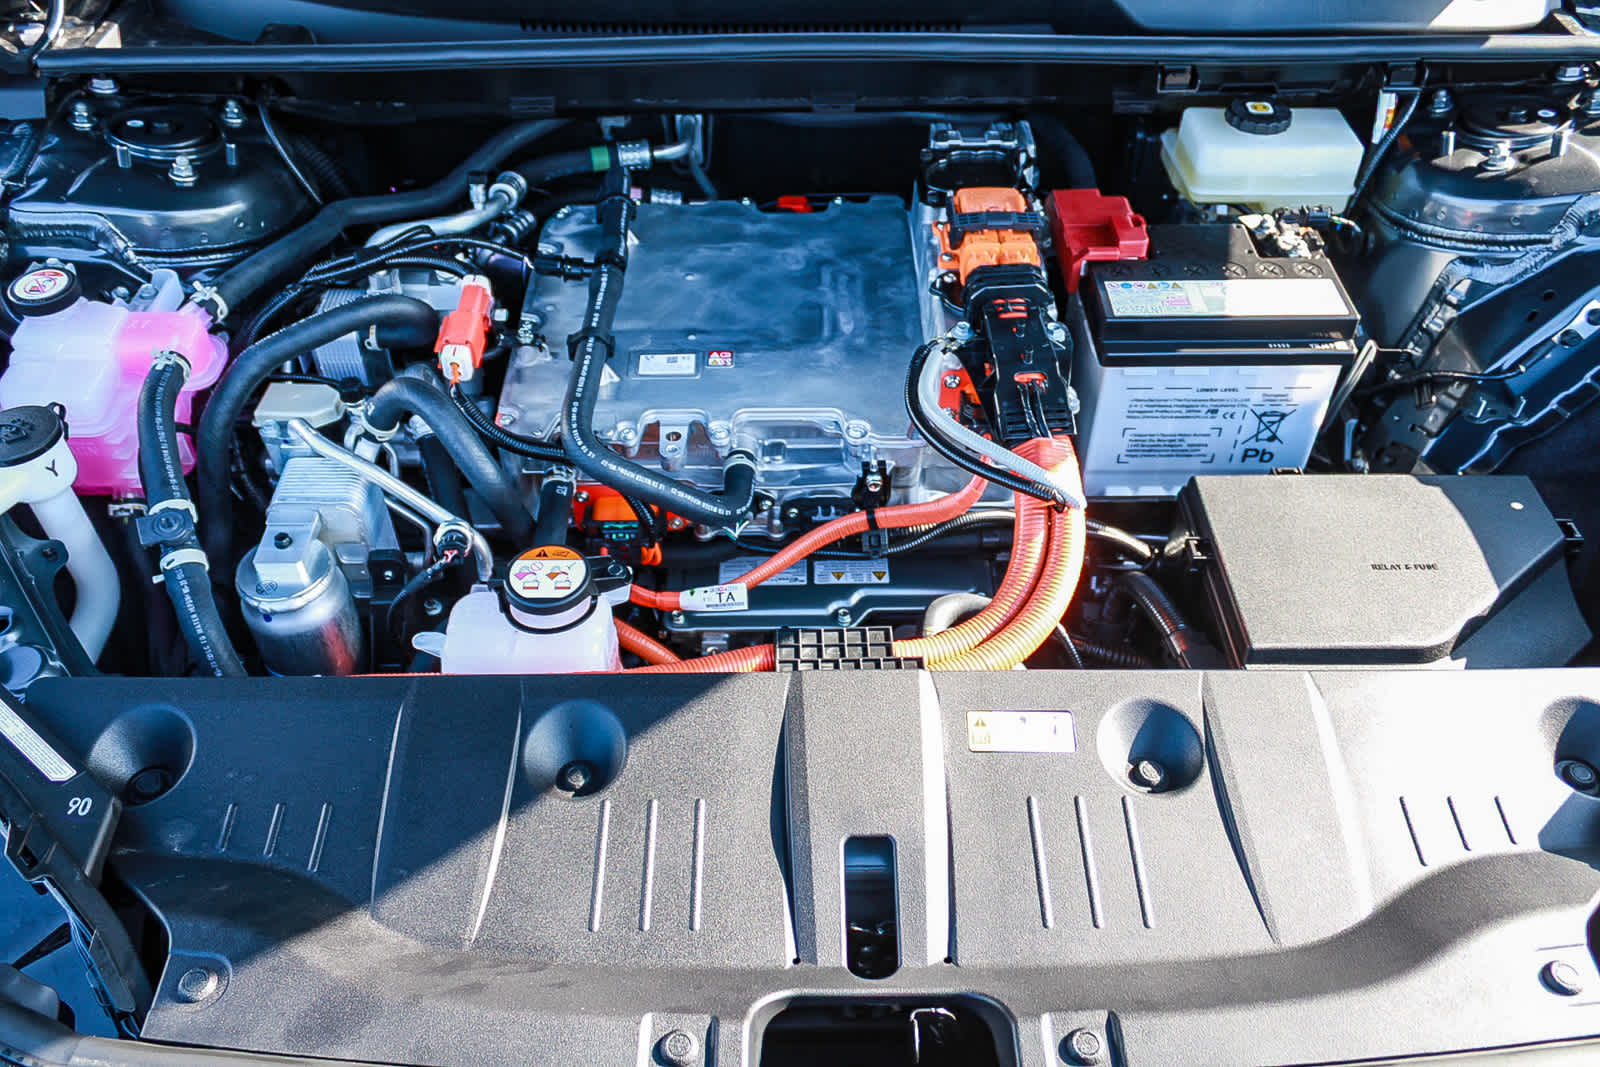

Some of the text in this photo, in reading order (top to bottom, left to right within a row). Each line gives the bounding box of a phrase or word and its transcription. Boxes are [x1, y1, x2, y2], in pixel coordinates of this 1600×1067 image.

[1240, 447, 1275, 463] Pb
[1370, 563, 1402, 571] RELAY
[715, 591, 736, 604] TA
[66, 796, 93, 816] 90
